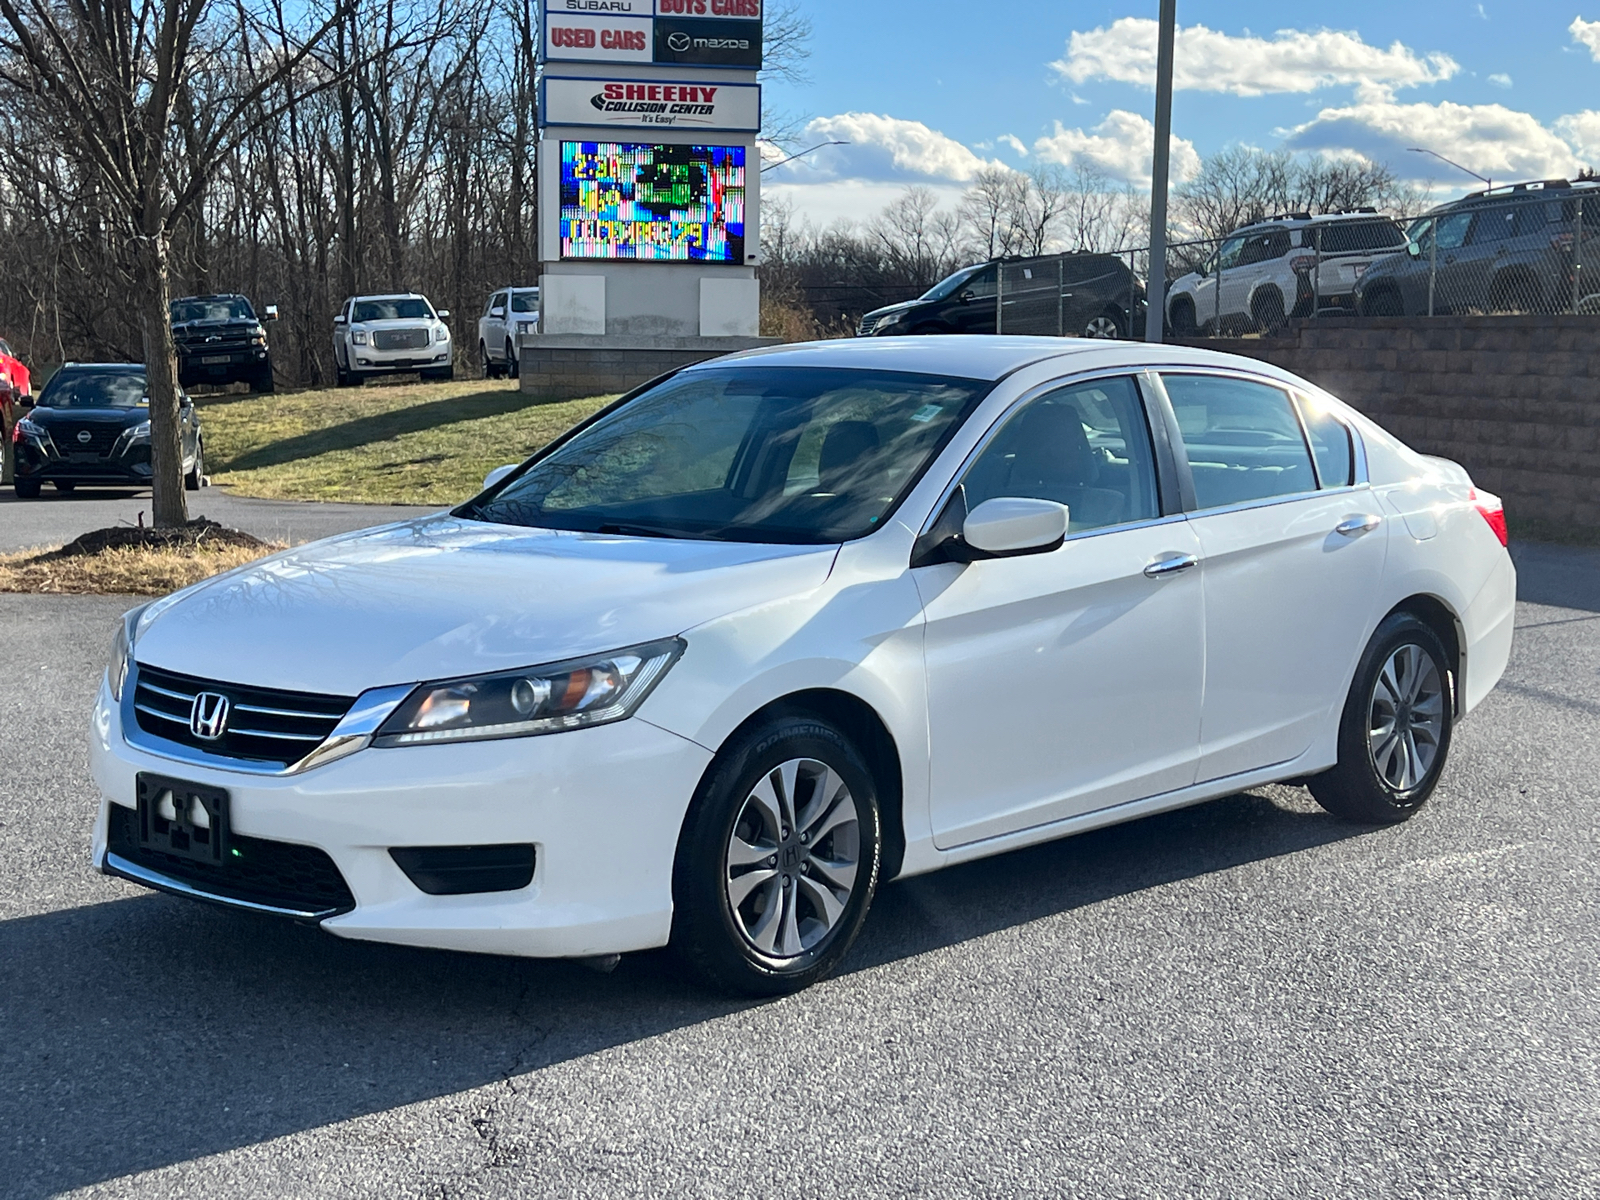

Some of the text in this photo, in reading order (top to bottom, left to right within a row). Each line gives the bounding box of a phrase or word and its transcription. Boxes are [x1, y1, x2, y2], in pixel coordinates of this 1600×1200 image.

[566, 0, 631, 11] SUBARU
[711, 0, 759, 16] CARS
[551, 27, 646, 50] USED CARS
[604, 84, 717, 103] SHEEHY
[604, 101, 715, 115] COLLISION CENTER
[641, 114, 676, 124] It's Easy!
